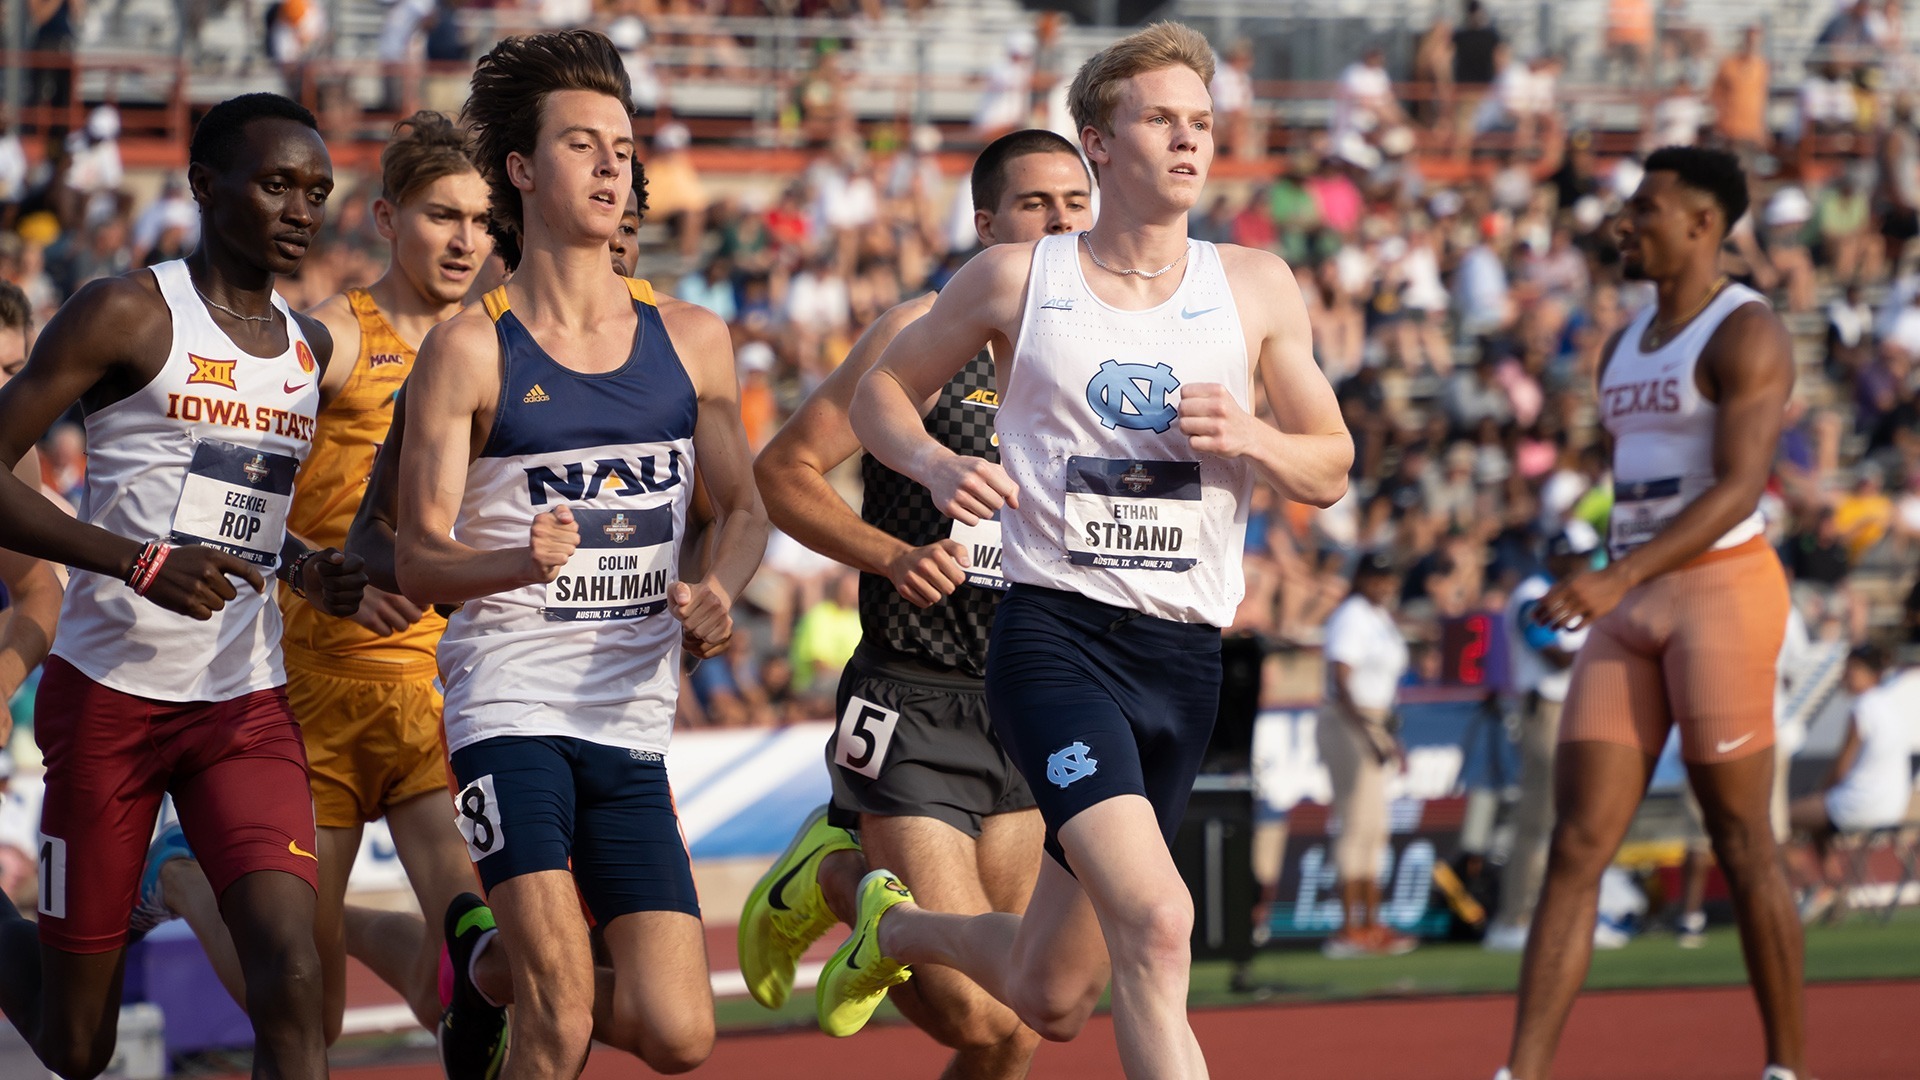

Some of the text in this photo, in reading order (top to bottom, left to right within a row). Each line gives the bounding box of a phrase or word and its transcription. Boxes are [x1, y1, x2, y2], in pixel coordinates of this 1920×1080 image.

[1043, 298, 1075, 308] ACC
[369, 353, 404, 368] MAAC
[523, 395, 550, 404] adidas
[1602, 378, 1680, 416] TEXAS
[166, 393, 251, 430] IOWA
[523, 450, 682, 506] NAU
[225, 491, 267, 513] EZEKIEL
[1114, 504, 1158, 520] ETHAN
[218, 511, 261, 542] ROP
[1085, 521, 1183, 552] STRAND
[238, 550, 255, 561] JUNE
[598, 555, 638, 570] COLIN
[1121, 559, 1130, 567] TX
[1140, 559, 1159, 568] JUNE
[1159, 560, 1173, 569] 7-10
[555, 568, 667, 602] SAHLMAN
[994, 579, 1004, 587] TX
[575, 605, 651, 619] AUSTIN, TX JUNE 7-10
[846, 705, 887, 769] 5
[629, 752, 662, 762] adidas
[461, 786, 495, 853] 8
[40, 841, 52, 911] 1
